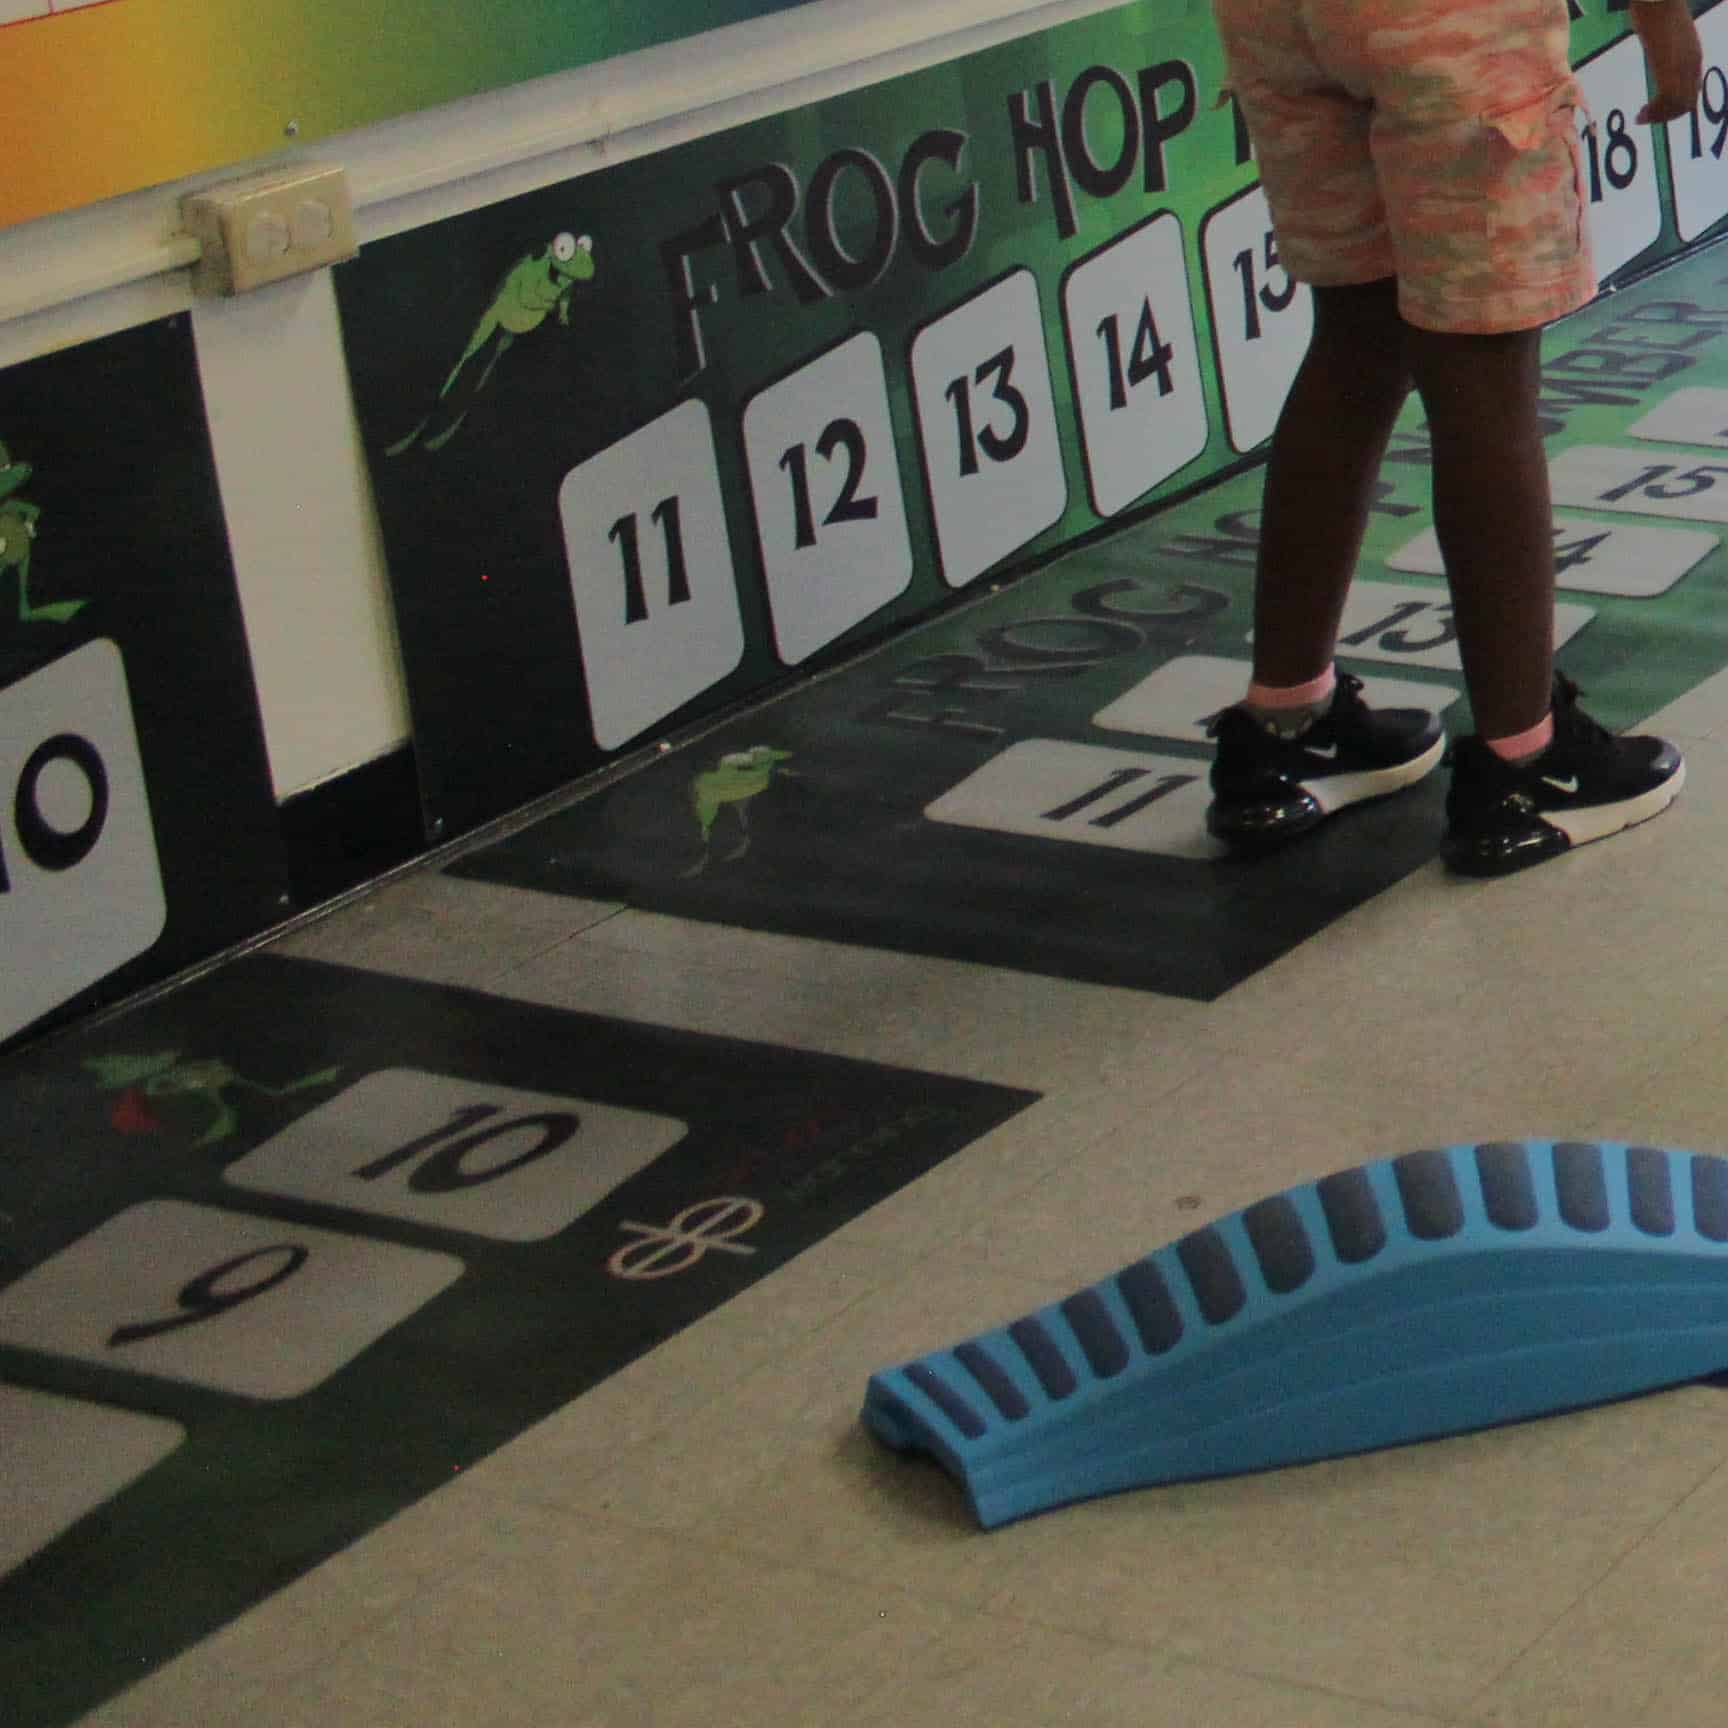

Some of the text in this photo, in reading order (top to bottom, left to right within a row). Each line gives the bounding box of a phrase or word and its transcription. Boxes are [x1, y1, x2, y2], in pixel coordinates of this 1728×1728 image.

[660, 58, 1197, 369] FROG HOP
[607, 495, 691, 626] 11
[778, 418, 880, 550] 12
[945, 345, 1030, 476] 13
[1096, 295, 1175, 412] 14
[1581, 108, 1639, 203] 18
[0, 733, 109, 893] 0
[1040, 767, 1200, 828] 11
[356, 1104, 580, 1195] 10
[106, 1243, 309, 1349] 9
